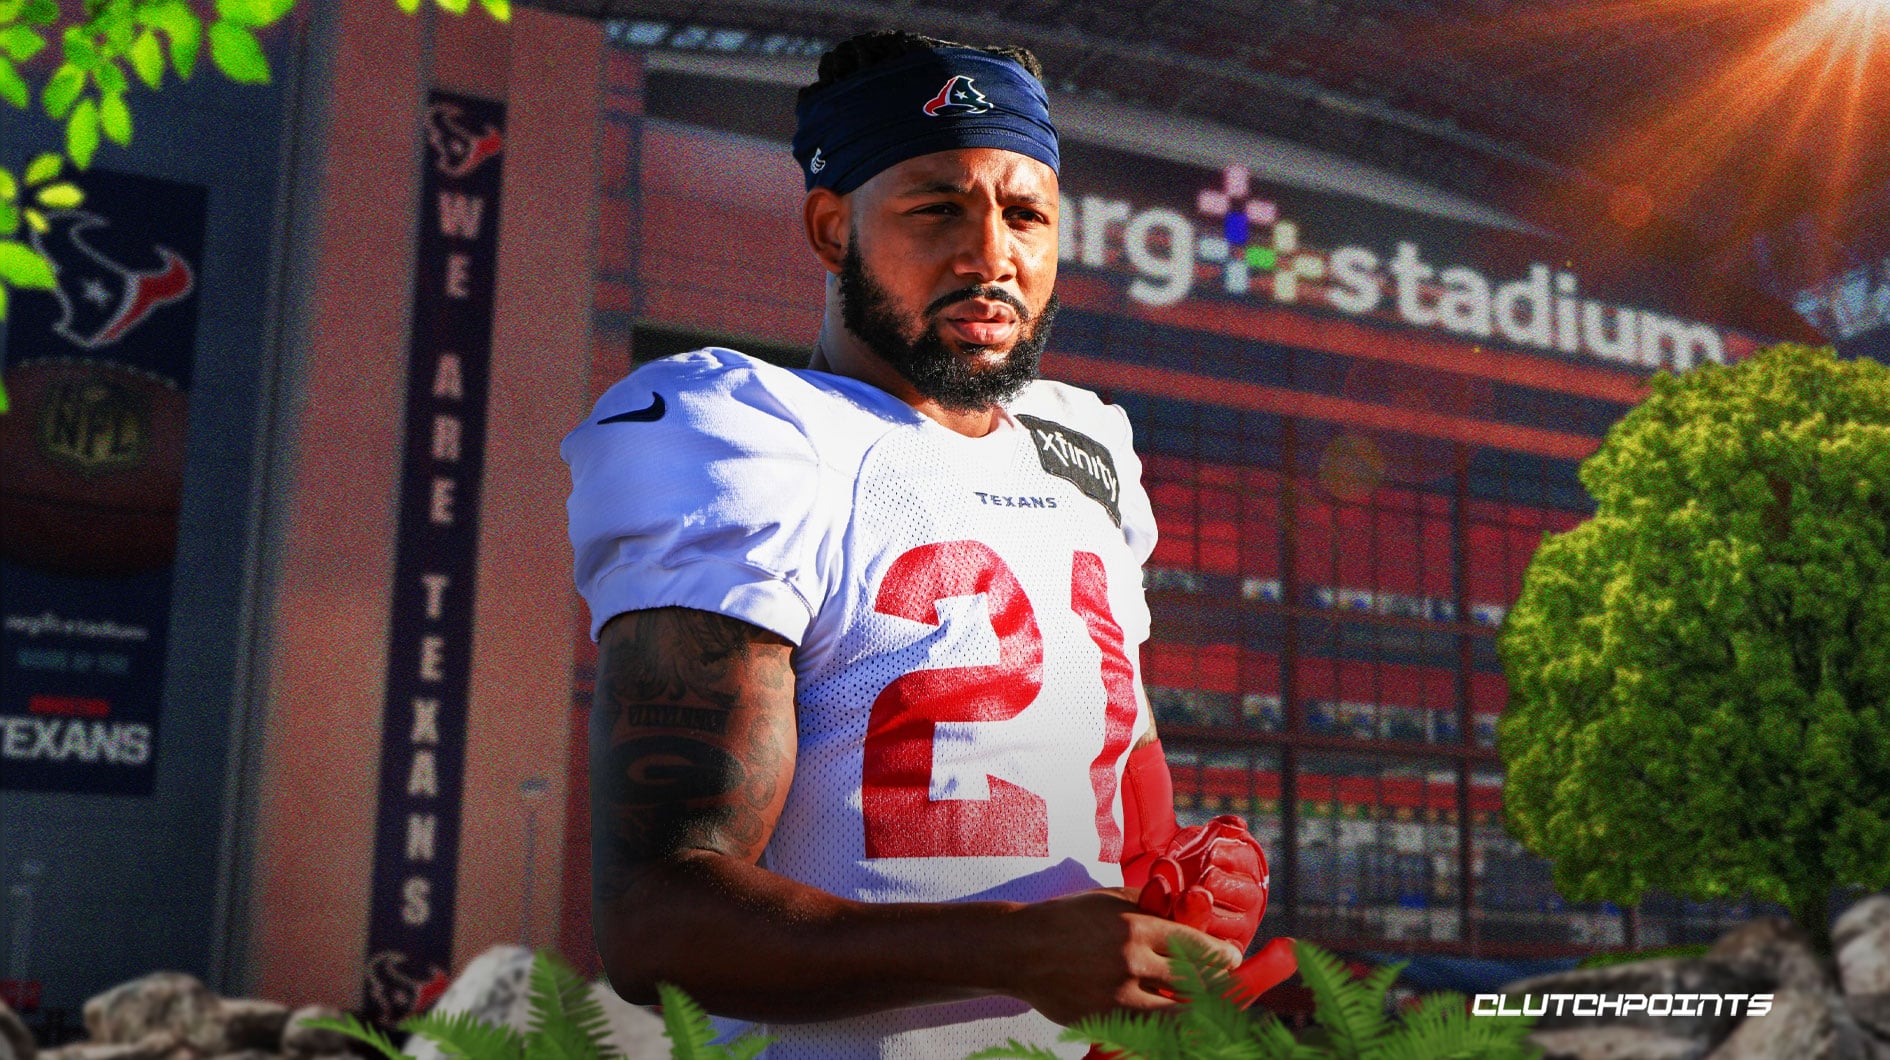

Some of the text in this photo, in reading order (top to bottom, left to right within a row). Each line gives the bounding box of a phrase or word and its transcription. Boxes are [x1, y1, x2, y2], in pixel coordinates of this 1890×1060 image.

[1324, 240, 1723, 370] stadium
[974, 491, 1058, 509] TEXANS
[1036, 428, 1118, 502] xfinity
[401, 191, 484, 926] WE ARE TEXANS
[0, 717, 150, 765] EXANS
[862, 540, 1140, 864] 21
